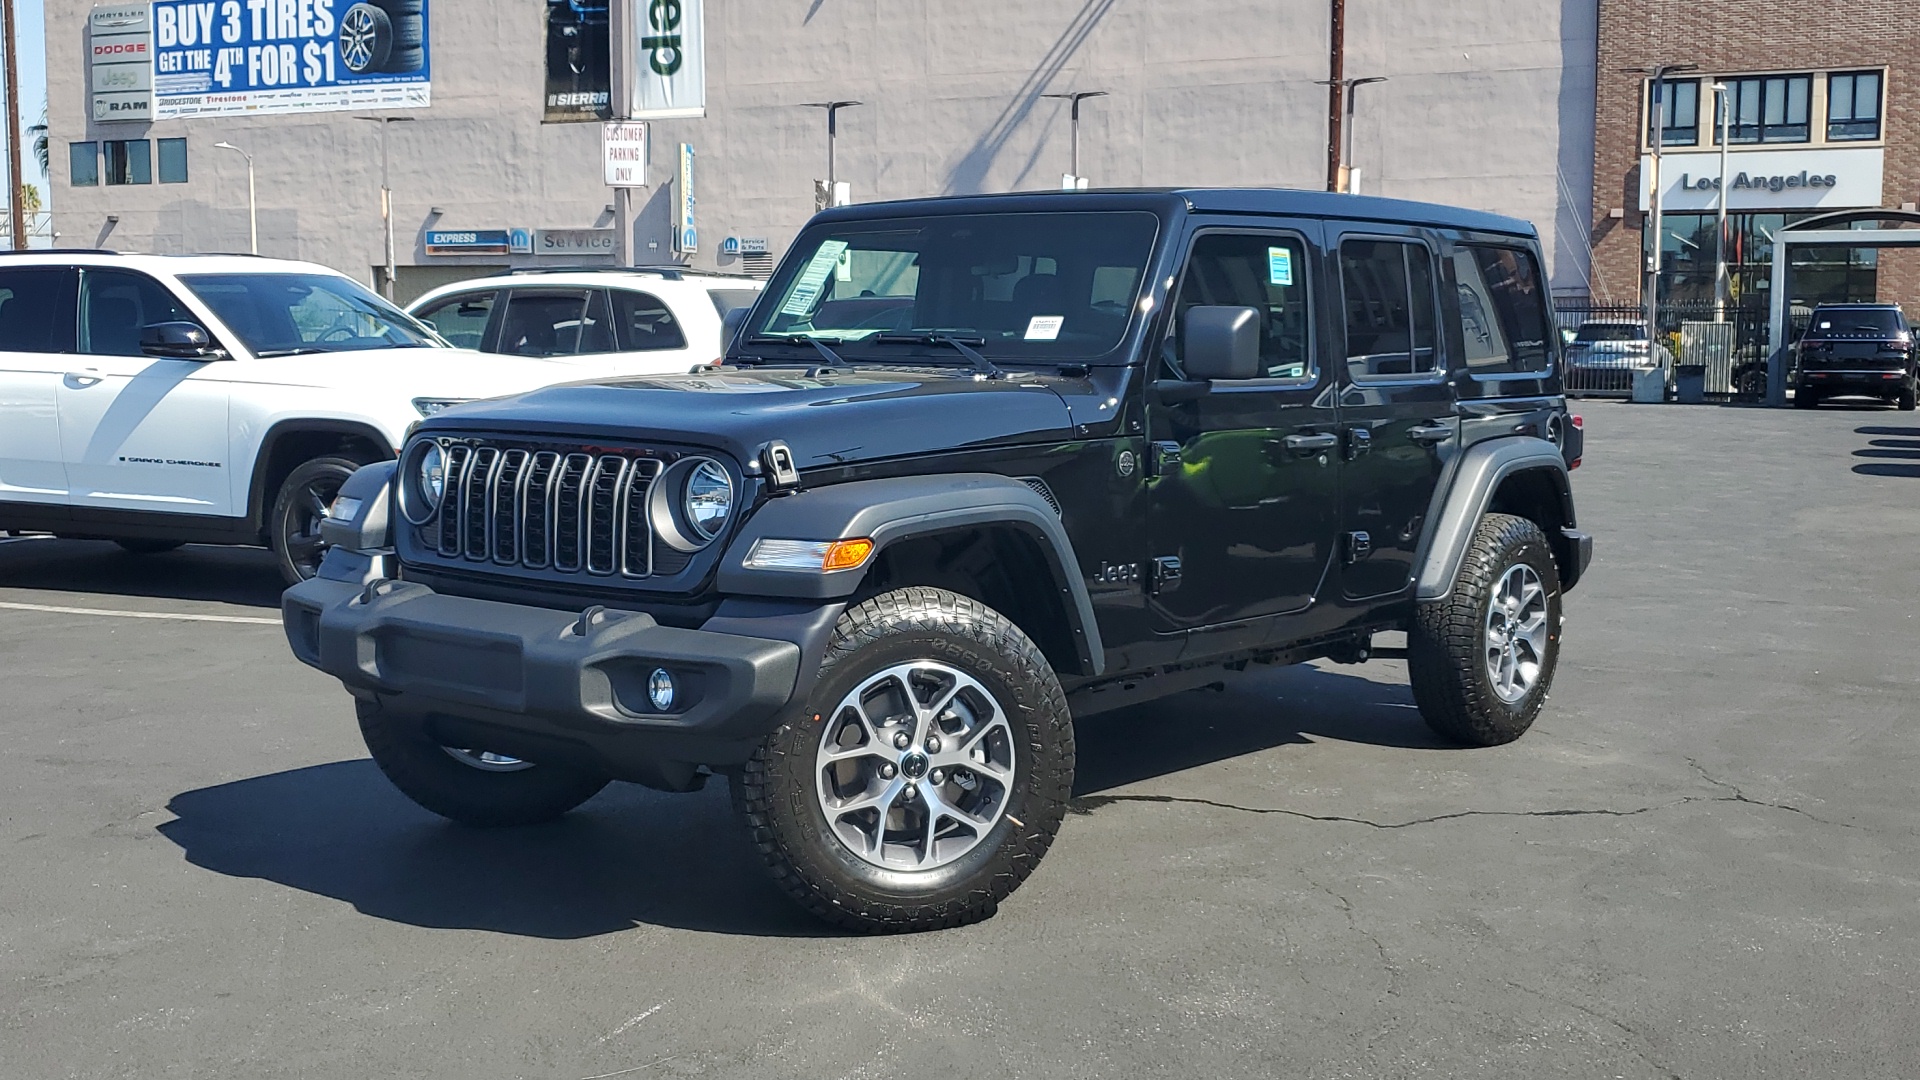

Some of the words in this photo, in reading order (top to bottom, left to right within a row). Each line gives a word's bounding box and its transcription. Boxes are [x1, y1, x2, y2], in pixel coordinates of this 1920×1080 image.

[94, 11, 144, 19] CHRYSLER
[157, 2, 215, 47] BUY
[221, 1, 241, 43] 3
[247, 0, 334, 41] TIRES
[94, 44, 146, 54] DODGE
[159, 51, 184, 72] GET
[185, 49, 211, 70] THE
[214, 47, 244, 88] 4TH
[248, 44, 298, 87] FOR
[303, 39, 335, 87] $1
[102, 68, 137, 88] Jeep
[159, 97, 202, 106] BRIDGESTONE
[206, 95, 247, 104] Firestone
[557, 91, 609, 106] SIERRA
[109, 101, 148, 111] RAM
[605, 127, 643, 141] CUSTOMER
[610, 147, 639, 161] PARKING
[616, 167, 632, 181] ONLY
[1682, 173, 1721, 190] Los
[1732, 170, 1836, 193] Angeles
[433, 233, 477, 244] EXPRESS
[544, 234, 612, 248] Service
[166, 459, 222, 467] CHEROKEE
[1094, 561, 1138, 585] Jeep
